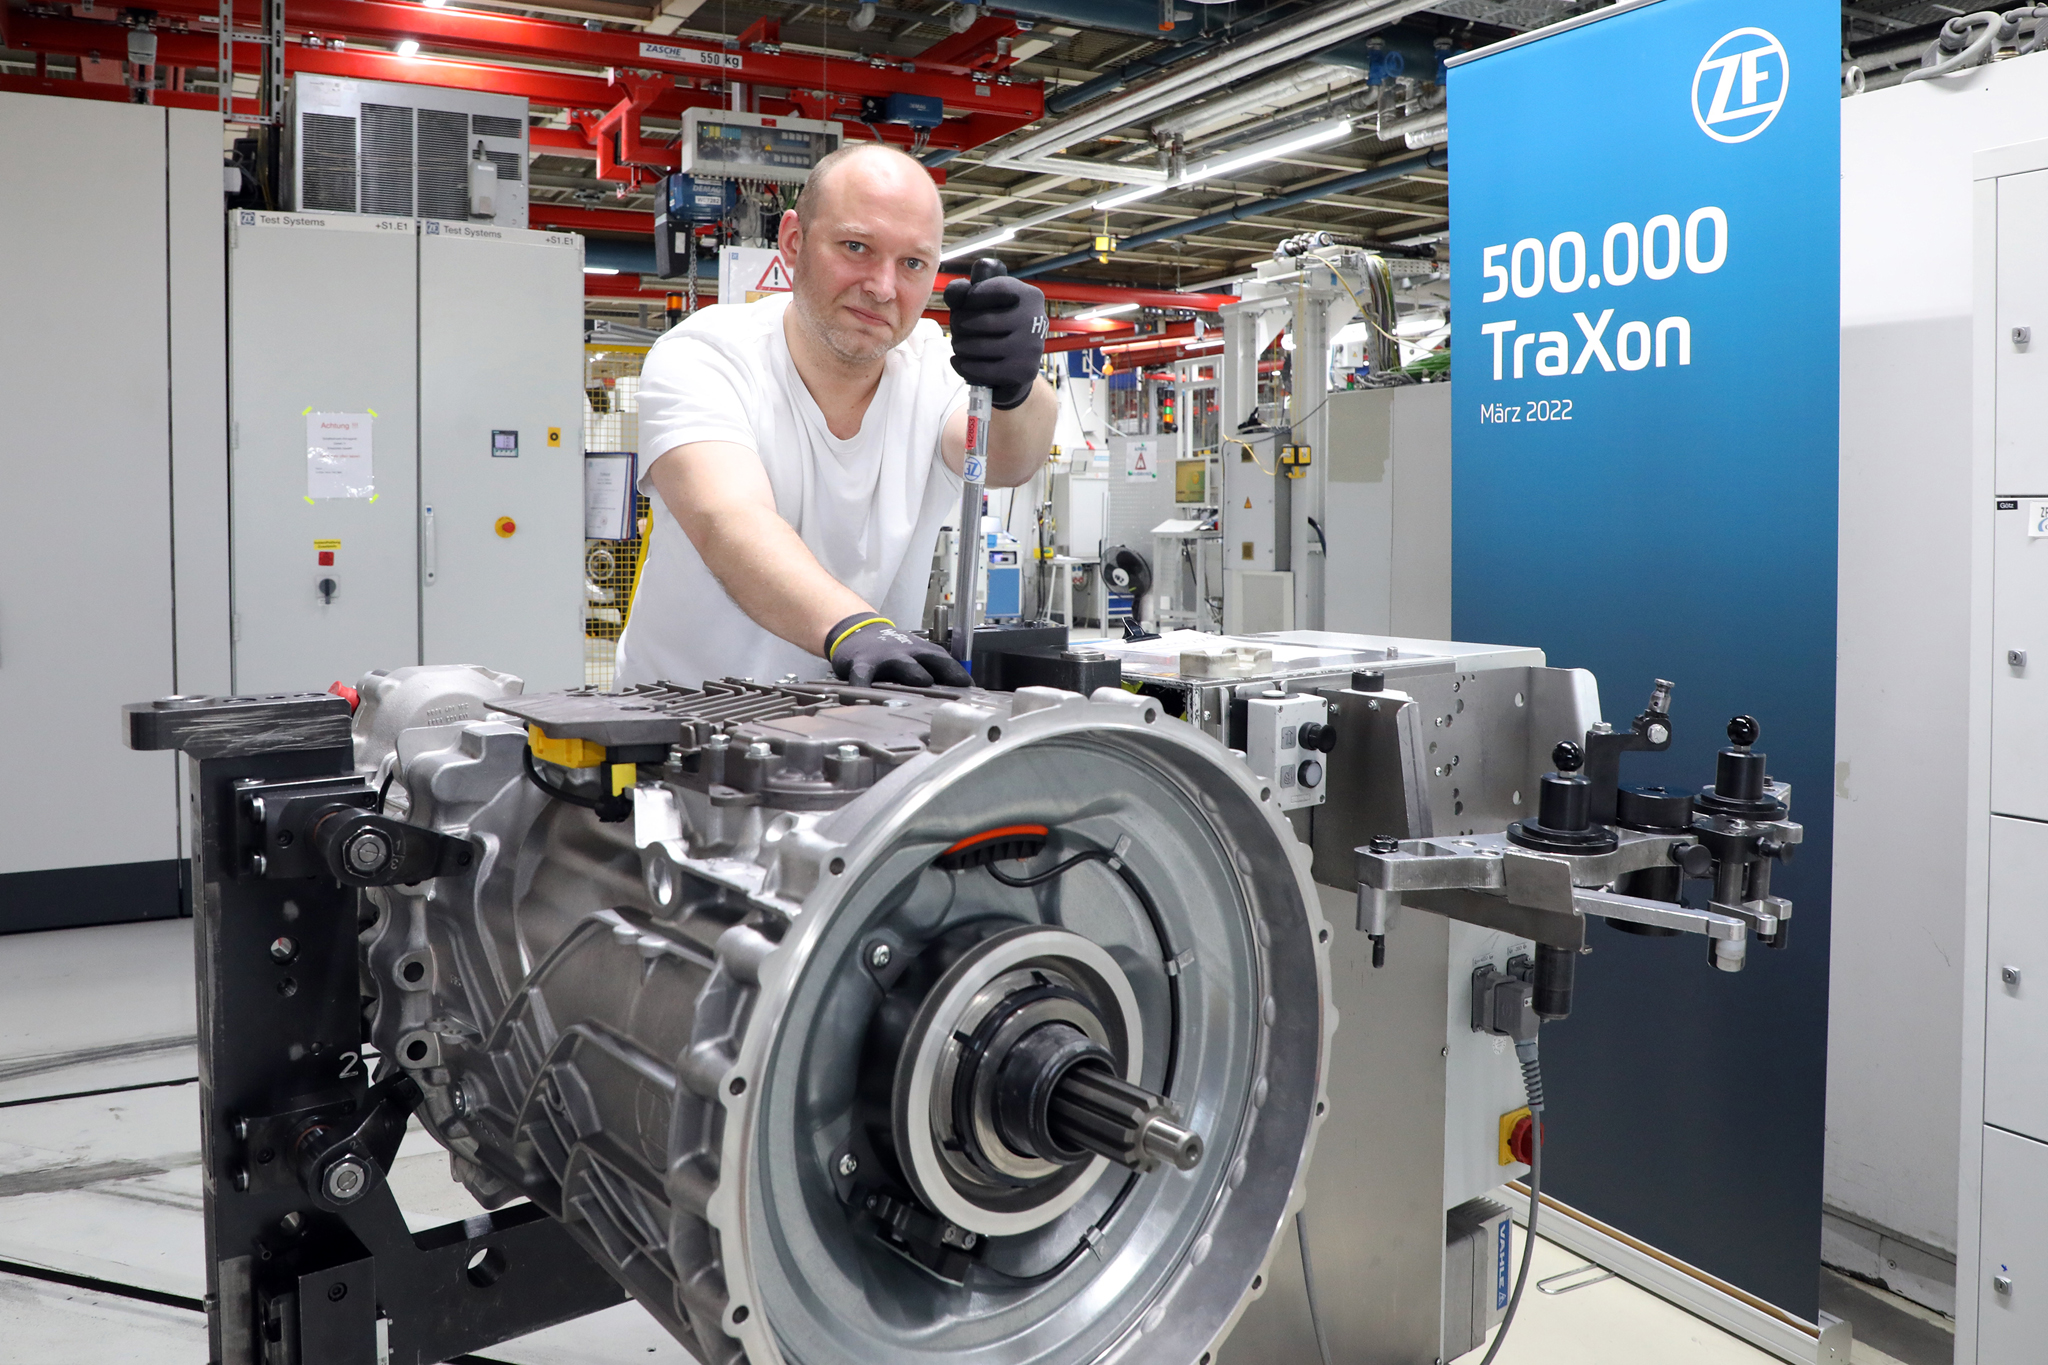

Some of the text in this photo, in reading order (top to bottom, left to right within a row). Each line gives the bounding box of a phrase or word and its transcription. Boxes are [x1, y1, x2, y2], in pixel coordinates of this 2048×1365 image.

[646, 45, 681, 56] ZASCHE
[700, 52, 740, 68] 550 kg
[1694, 32, 1787, 136] ZF
[693, 185, 722, 193] DEMAG
[260, 215, 325, 227] Test Systems
[443, 225, 502, 239] Test Systems
[1482, 206, 1728, 303] 500.000
[1481, 308, 1691, 380] TraXon
[1480, 399, 1573, 424] März 2022
[321, 422, 350, 430] Achtung
[964, 457, 982, 481] ZF
[339, 1051, 359, 1079] 2
